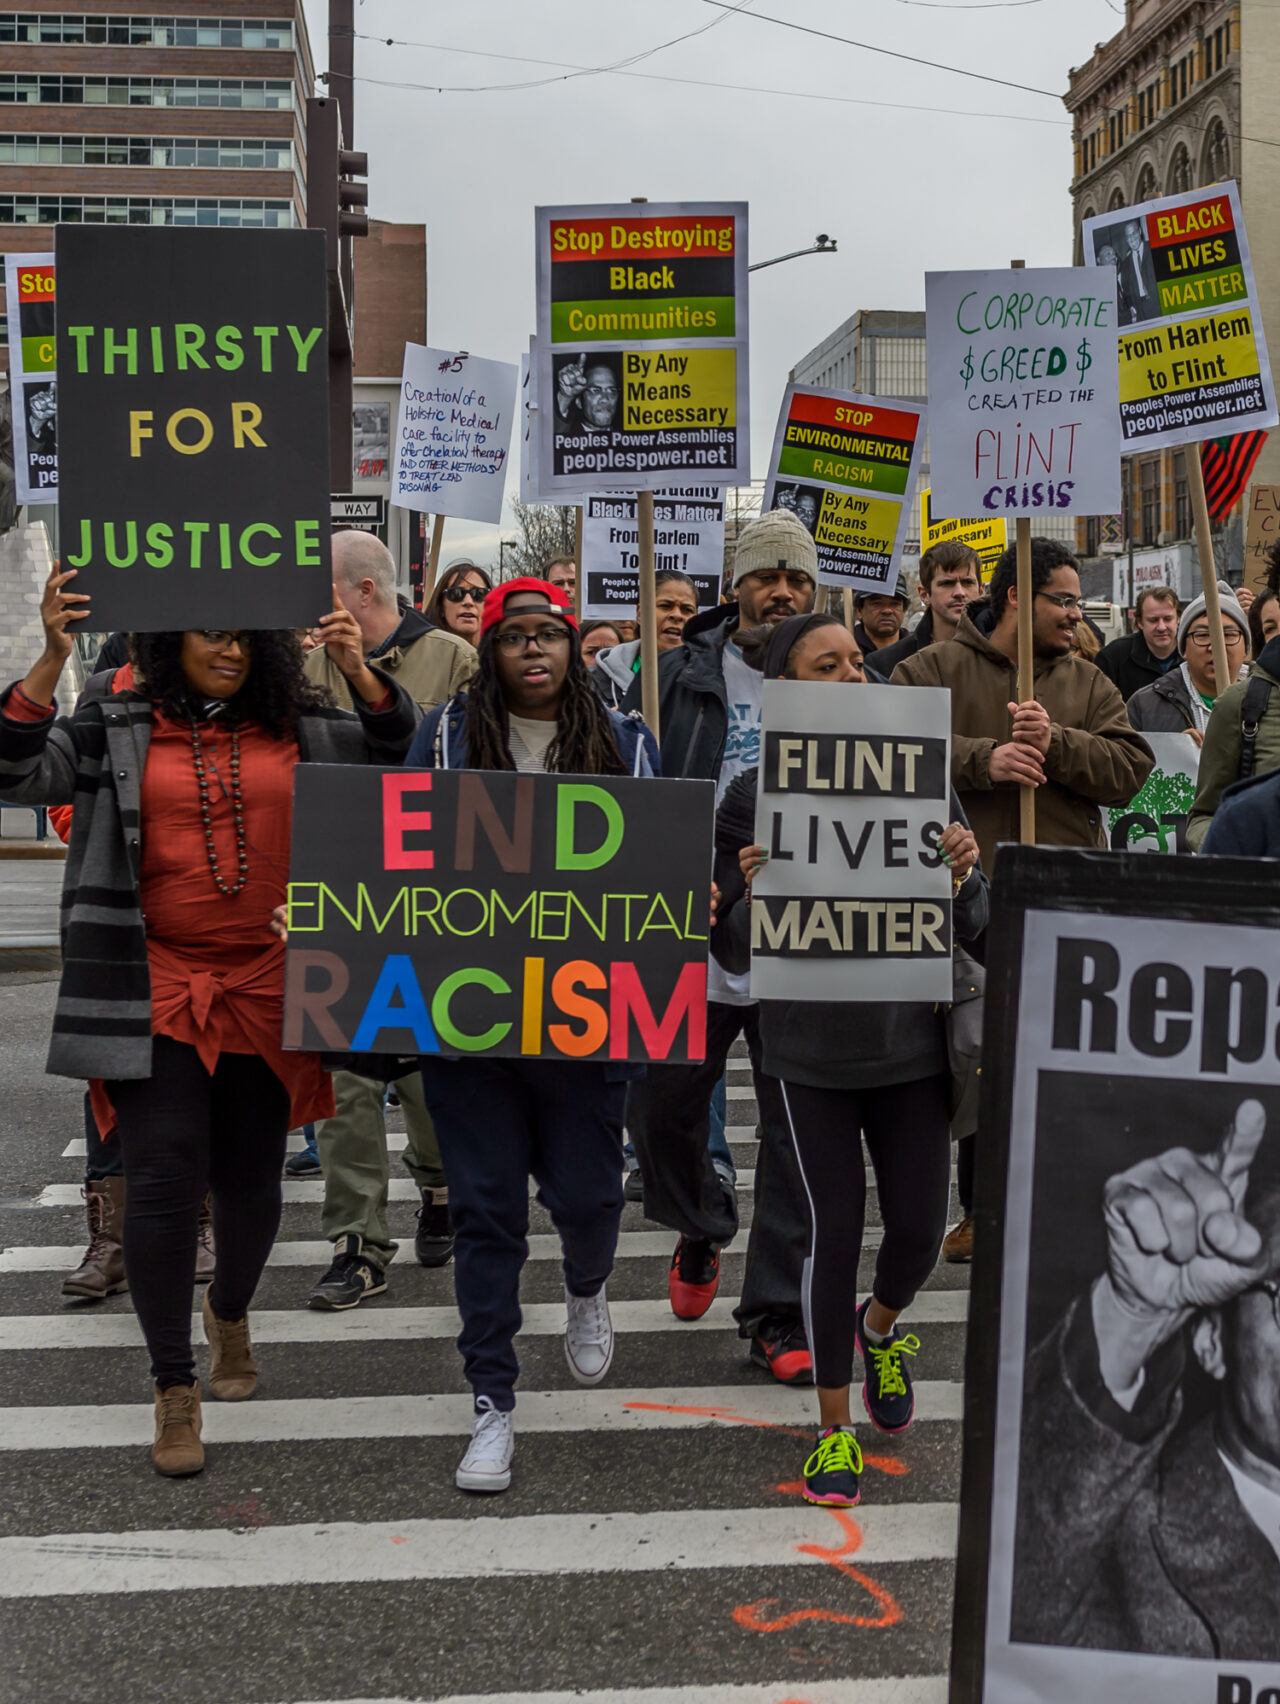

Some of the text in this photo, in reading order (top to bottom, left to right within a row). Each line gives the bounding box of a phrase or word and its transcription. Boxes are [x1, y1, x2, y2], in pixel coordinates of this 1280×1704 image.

[1156, 203, 1226, 239] BLACK
[554, 224, 732, 254] Stop Destroying
[1167, 239, 1228, 272] LIVES
[21, 274, 55, 293] Sto
[610, 266, 675, 290] Black
[1161, 272, 1244, 309] MATTER
[569, 306, 717, 331] Communities
[956, 291, 1113, 334] CORPORATE
[68, 322, 323, 376] THIRSTY
[1167, 316, 1251, 356] Harlem
[627, 354, 688, 377] By Any
[1147, 354, 1228, 391] to Flint
[463, 390, 477, 406] of
[627, 382, 691, 401] Means
[968, 388, 1095, 411] CREATED THE
[1121, 377, 1261, 416] Peoples Power Assemblies
[450, 409, 500, 431] Medical
[627, 406, 728, 426] Necessary
[834, 407, 874, 427] STOP
[1126, 391, 1263, 437] peoplespower.net
[130, 402, 267, 457] FOR
[474, 432, 486, 444] to
[555, 429, 735, 450] Peoples Power Assemblies
[786, 426, 910, 462] ENVIRONMENTAL
[418, 459, 449, 470] OTHER
[450, 461, 496, 474] METHODS
[563, 446, 726, 474] peoplespower.net
[813, 458, 874, 484] RACISM
[344, 503, 372, 515] WAY
[592, 501, 631, 518] Black
[674, 504, 720, 521] Matter
[825, 491, 870, 515] By Any
[821, 511, 867, 530] Means
[928, 528, 940, 541] By
[942, 519, 957, 535] any
[67, 519, 322, 569] JUSTICE
[817, 527, 889, 553] Necessary
[620, 551, 639, 568] To
[835, 548, 889, 565] Assemblies
[602, 578, 636, 588] People's
[777, 739, 924, 794] FLINT
[382, 772, 625, 874] END
[771, 811, 944, 870] LIVES
[287, 881, 708, 942] ENVIROMENTAL
[751, 900, 945, 953] MATTER
[284, 949, 707, 1061] RACISM
